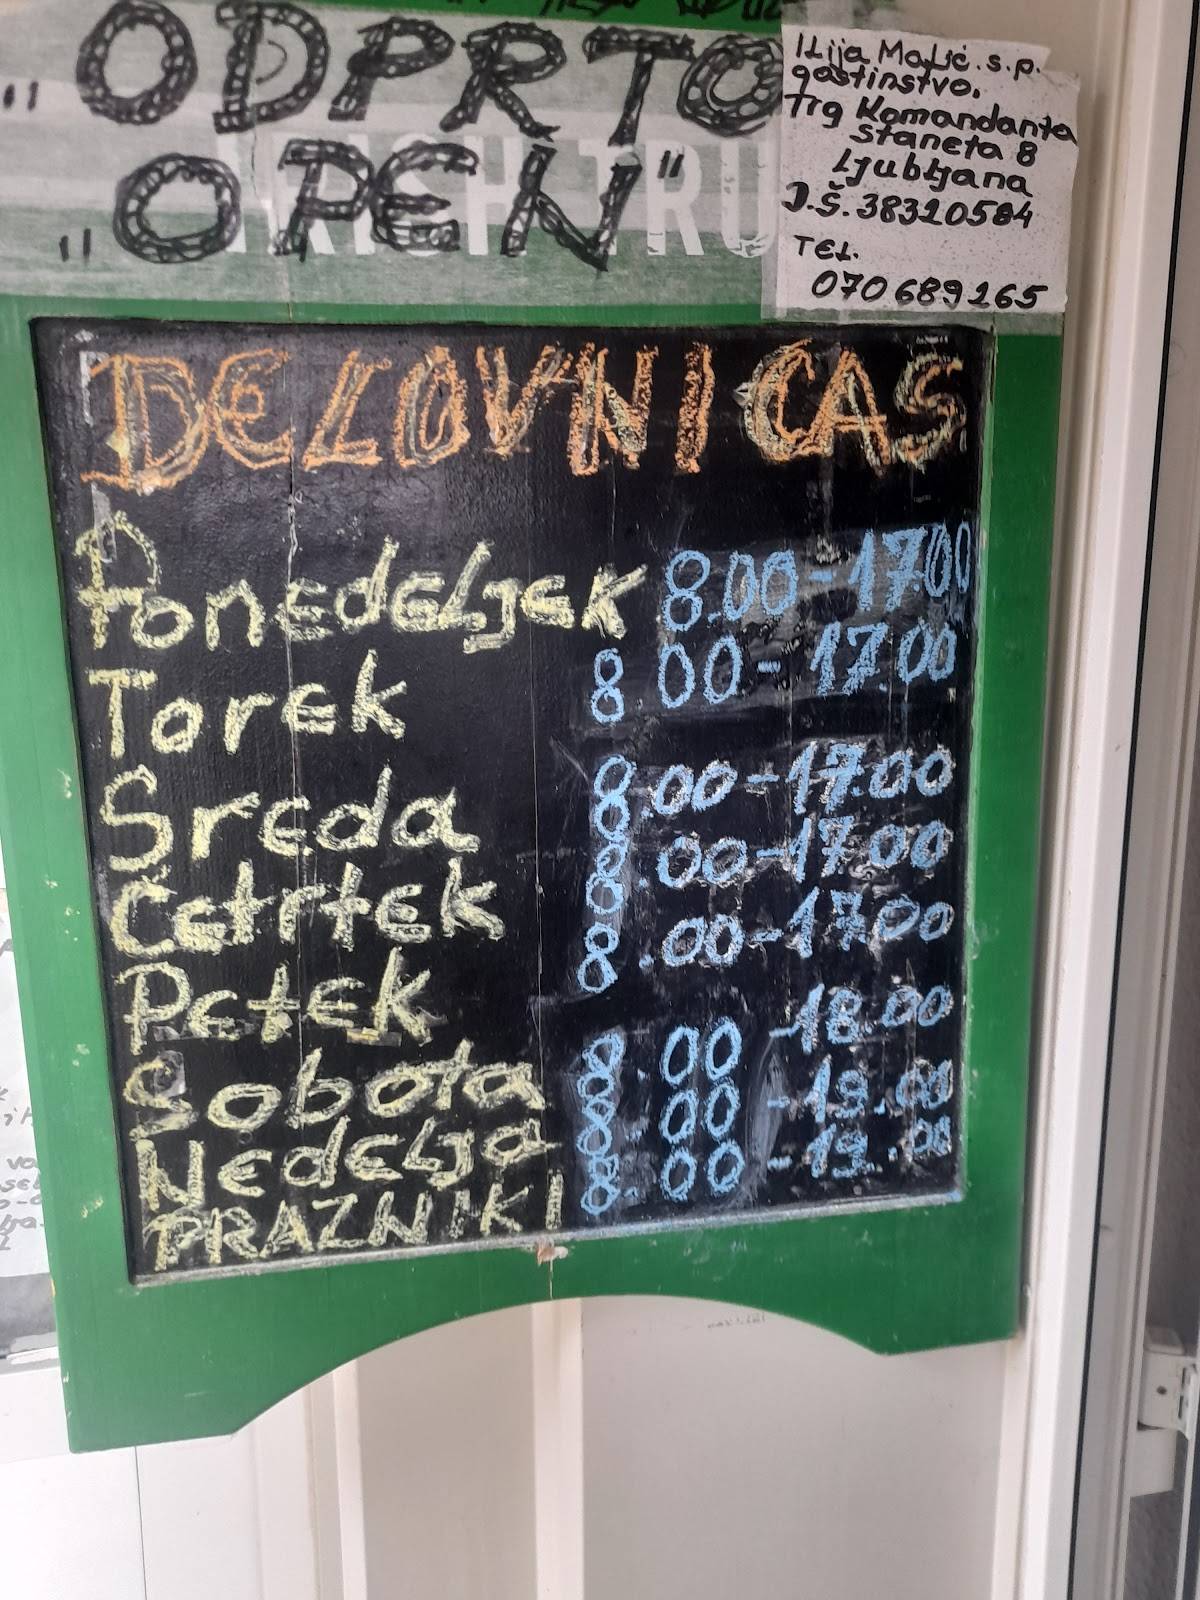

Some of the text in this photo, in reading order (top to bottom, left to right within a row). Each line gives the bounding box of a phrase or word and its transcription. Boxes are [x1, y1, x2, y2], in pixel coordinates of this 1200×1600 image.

[1016, 141, 1038, 167] 8
[86, 649, 408, 760] Torek
[98, 760, 481, 872] Sreda
[112, 947, 433, 1055] Petek
[122, 1039, 546, 1140] Sobota
[141, 1168, 564, 1272] PRAZNIKI
